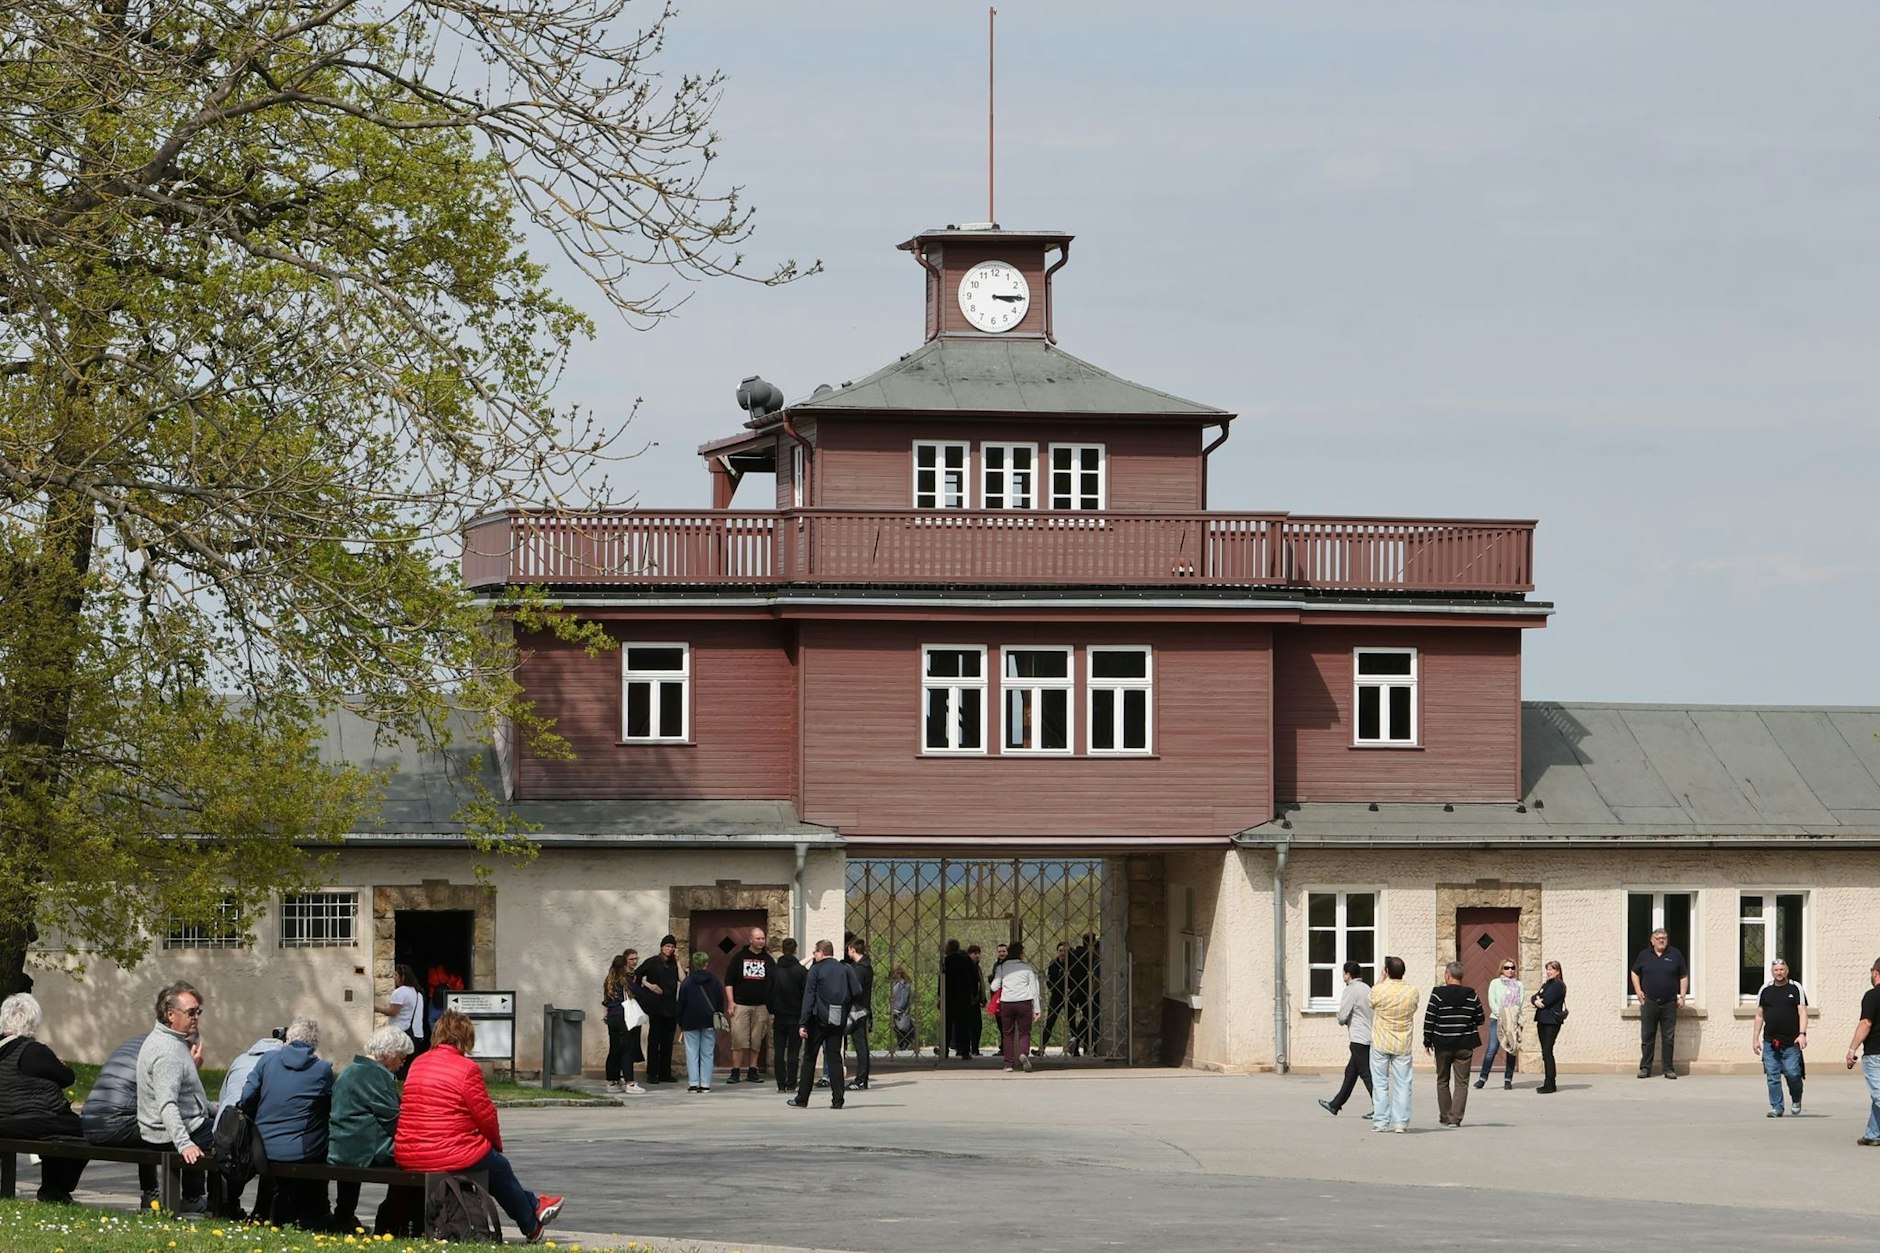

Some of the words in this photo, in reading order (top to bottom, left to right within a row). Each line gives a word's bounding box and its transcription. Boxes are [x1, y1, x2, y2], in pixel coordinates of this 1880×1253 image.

[991, 269, 999, 277] 12
[971, 281, 979, 289] 10
[1013, 281, 1018, 289] 2
[966, 292, 972, 300] 9
[991, 317, 996, 325] 6
[743, 961, 765, 969] FCK
[743, 969, 765, 977] NZS
